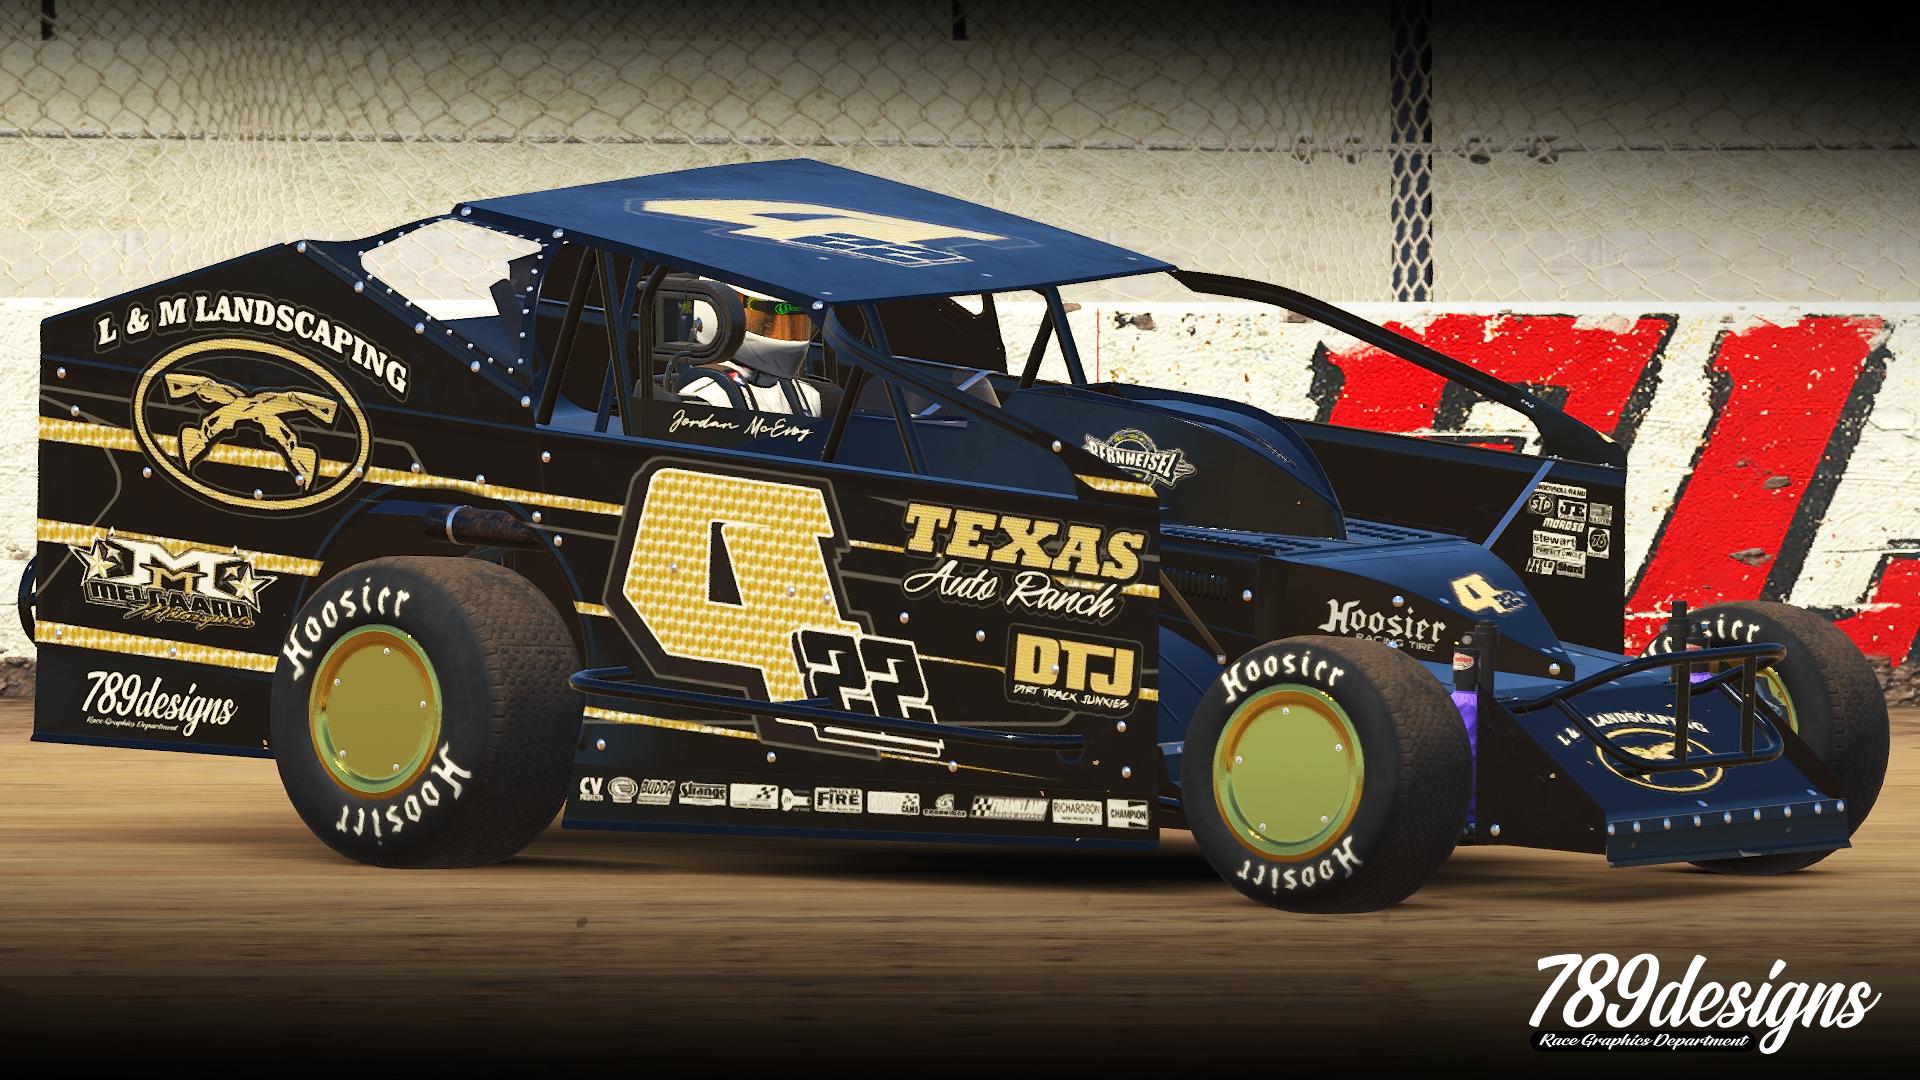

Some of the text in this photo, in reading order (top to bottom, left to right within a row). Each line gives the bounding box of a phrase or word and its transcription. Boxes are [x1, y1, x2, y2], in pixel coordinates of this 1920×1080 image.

[642, 199, 1010, 245] 4
[98, 296, 408, 394] L & M LANDSCAPING
[668, 409, 815, 442] Jordan McEvoy
[1531, 496, 1551, 511] STP
[1543, 518, 1585, 532] MOROSO
[1560, 501, 1585, 517] JE
[906, 503, 1145, 580] TEXAS
[1534, 533, 1576, 549] stewart
[1591, 534, 1608, 548] 76
[623, 468, 862, 723] 4
[904, 560, 1117, 618] Auto Ranch
[1452, 573, 1508, 614] 4
[282, 577, 411, 681] Hoosier
[1318, 598, 1447, 643] Hoosier
[1013, 633, 1135, 696] DTJ
[1409, 641, 1436, 653] TIRE
[791, 627, 945, 750] 22
[1012, 683, 1130, 709] DIRT TRACK JUNKIES
[1220, 650, 1345, 704] Hoosier
[82, 670, 238, 737] 789designs
[335, 741, 473, 847] Hoosier
[579, 776, 604, 795] CV
[816, 791, 861, 807] FIRE
[1053, 801, 1101, 815] RICHARDSON
[1110, 808, 1148, 820] CHAMPION
[1236, 835, 1365, 895] Hoosier
